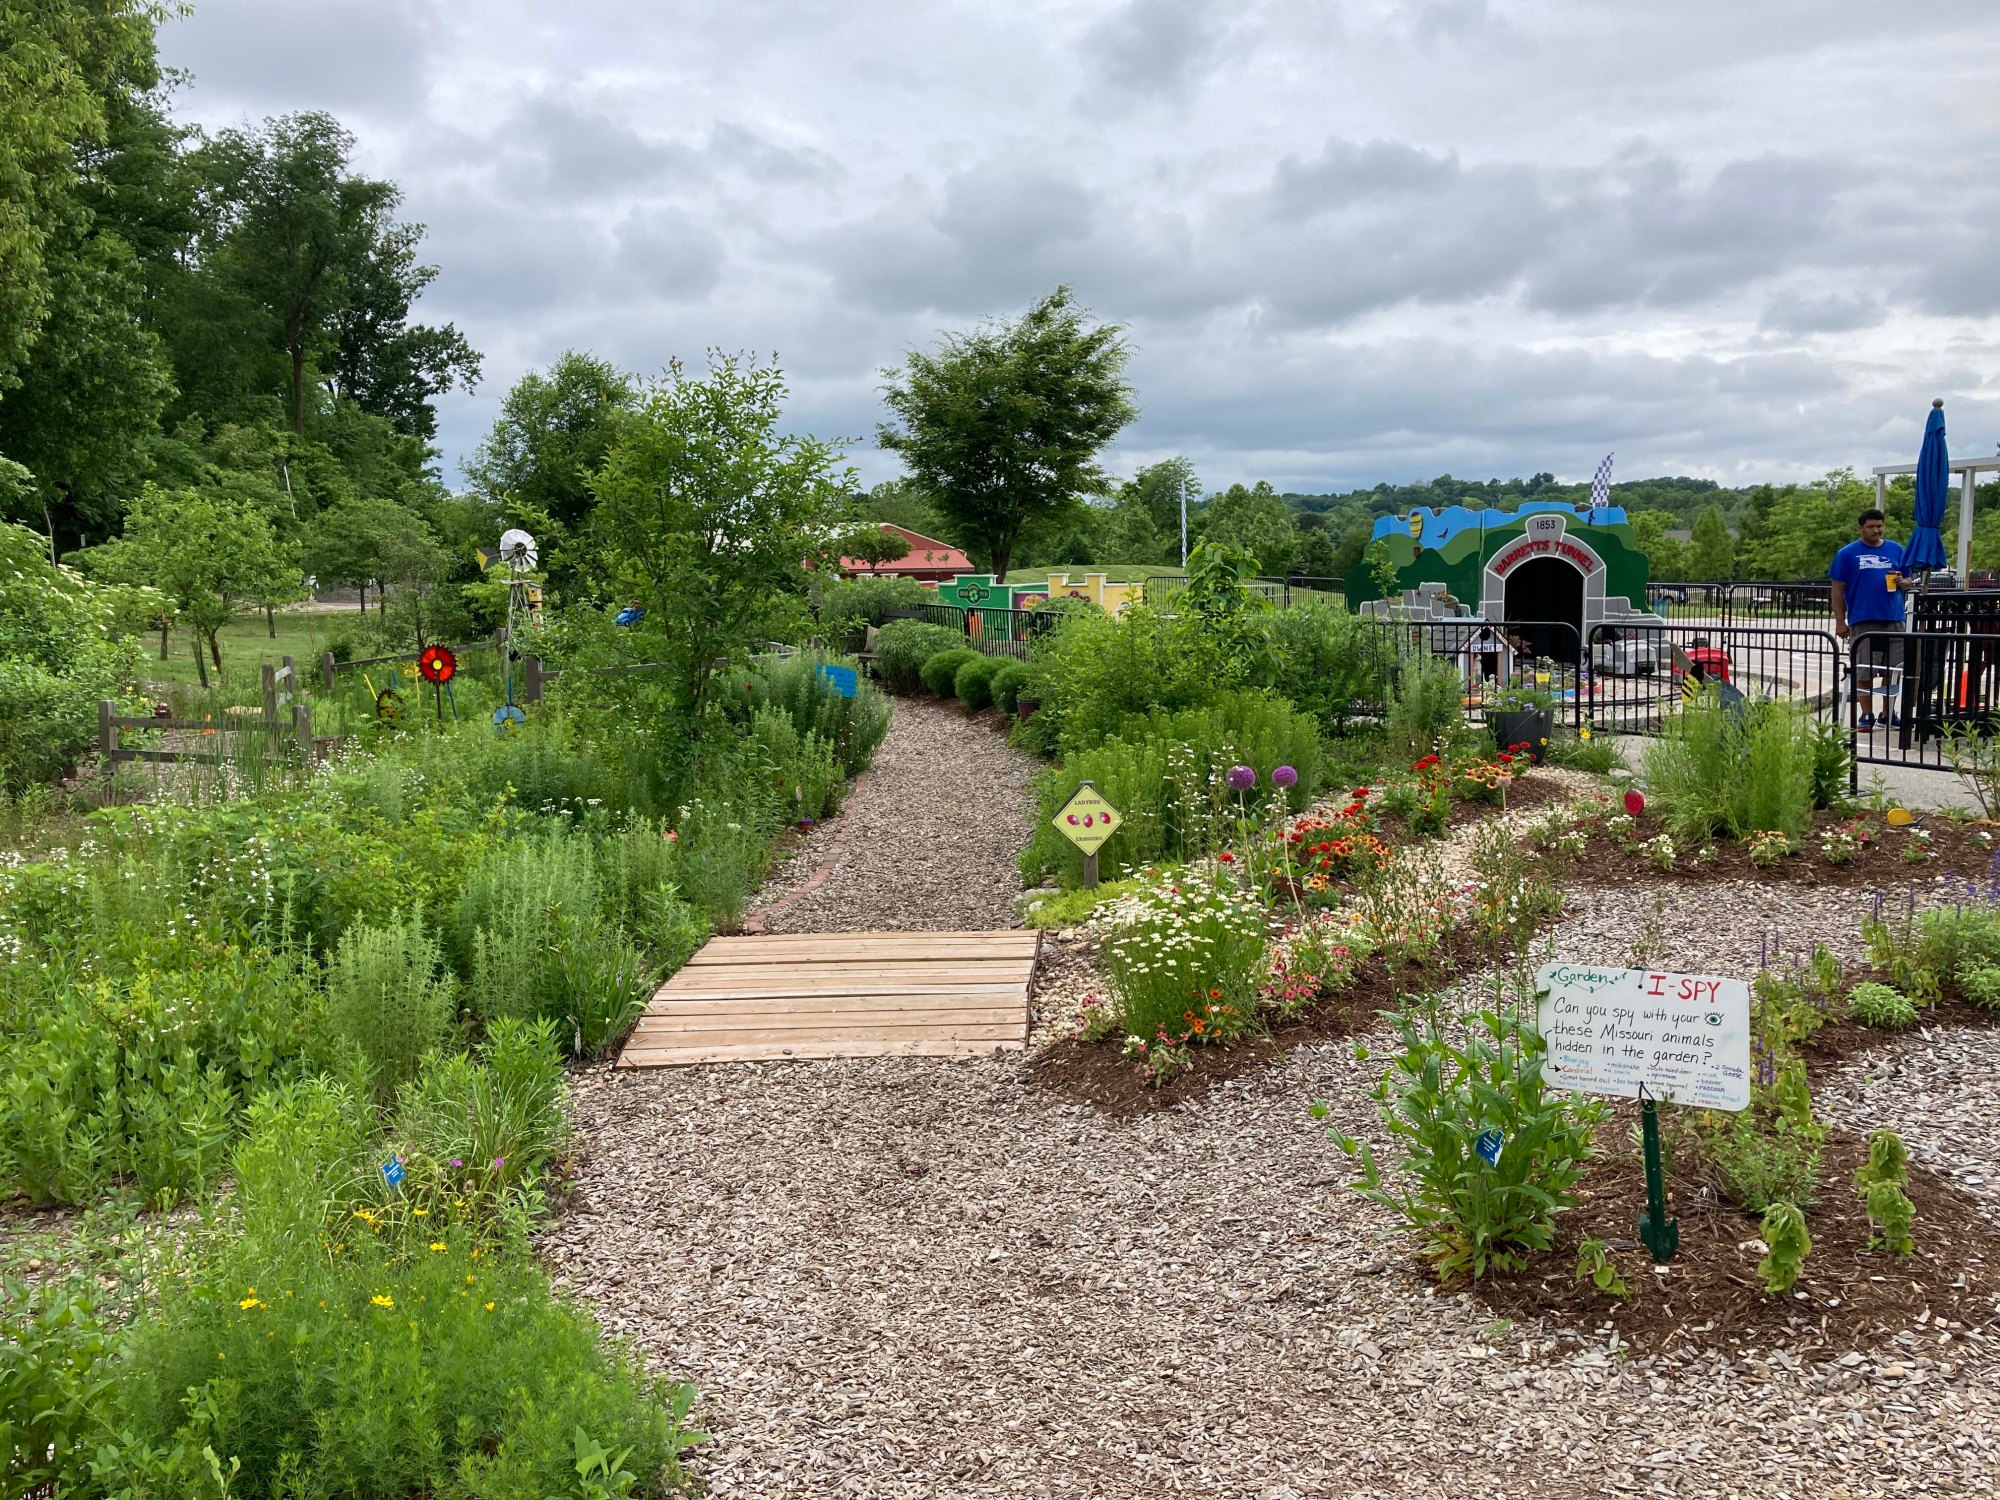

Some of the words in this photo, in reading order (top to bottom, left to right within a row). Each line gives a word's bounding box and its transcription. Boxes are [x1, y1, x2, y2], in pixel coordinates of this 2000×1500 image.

[1536, 520, 1556, 530] 1853
[1494, 540, 1551, 576] BARRETTS
[1555, 540, 1595, 573] TUNNEL
[1557, 967, 1608, 984] Garden
[1647, 974, 1721, 1003] I-SPY
[1554, 997, 1579, 1015] Can
[1583, 1004, 1607, 1024] you
[1612, 1007, 1635, 1026] spy
[1643, 1008, 1667, 1021] with
[1672, 1012, 1700, 1029] your
[1552, 1019, 1593, 1037] these
[1600, 1023, 1653, 1041] Missouri
[1662, 1031, 1715, 1048] animals
[1555, 1037, 1593, 1053] hidden
[1602, 1044, 1615, 1056] in
[1622, 1045, 1644, 1059] the
[1650, 1050, 1713, 1068] garden?
